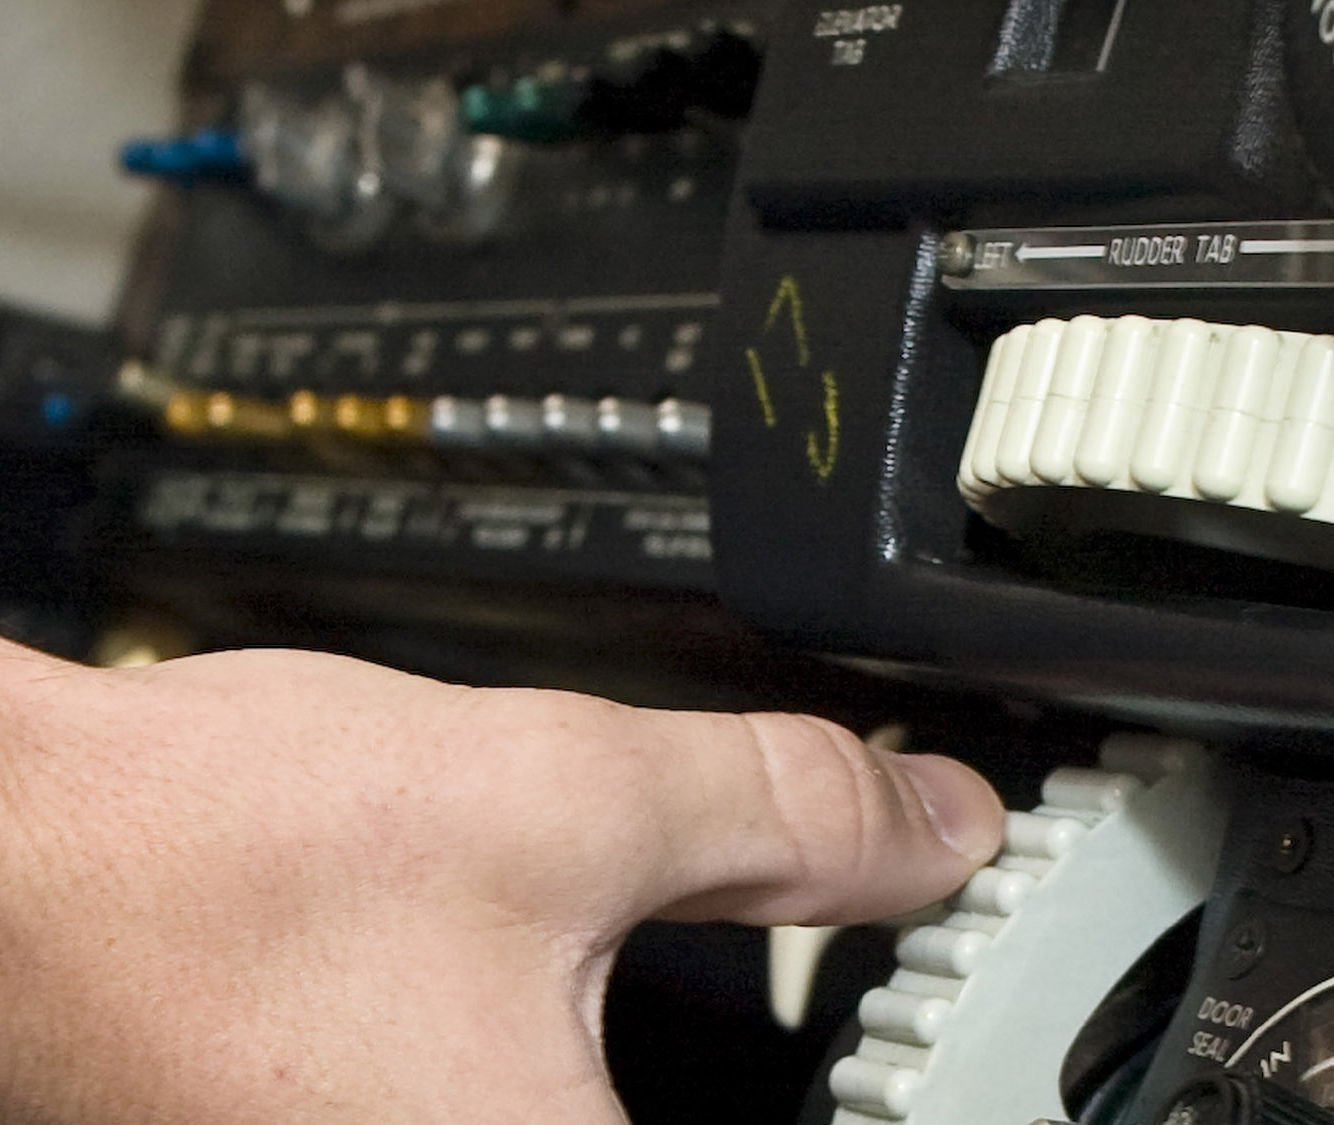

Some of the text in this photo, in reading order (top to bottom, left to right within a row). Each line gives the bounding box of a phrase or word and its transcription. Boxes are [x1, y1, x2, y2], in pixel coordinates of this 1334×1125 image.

[974, 234, 1238, 270] LEFT RUDDER TAB
[1197, 996, 1254, 1029] DOOR
[1188, 1031, 1229, 1062] SEAL
